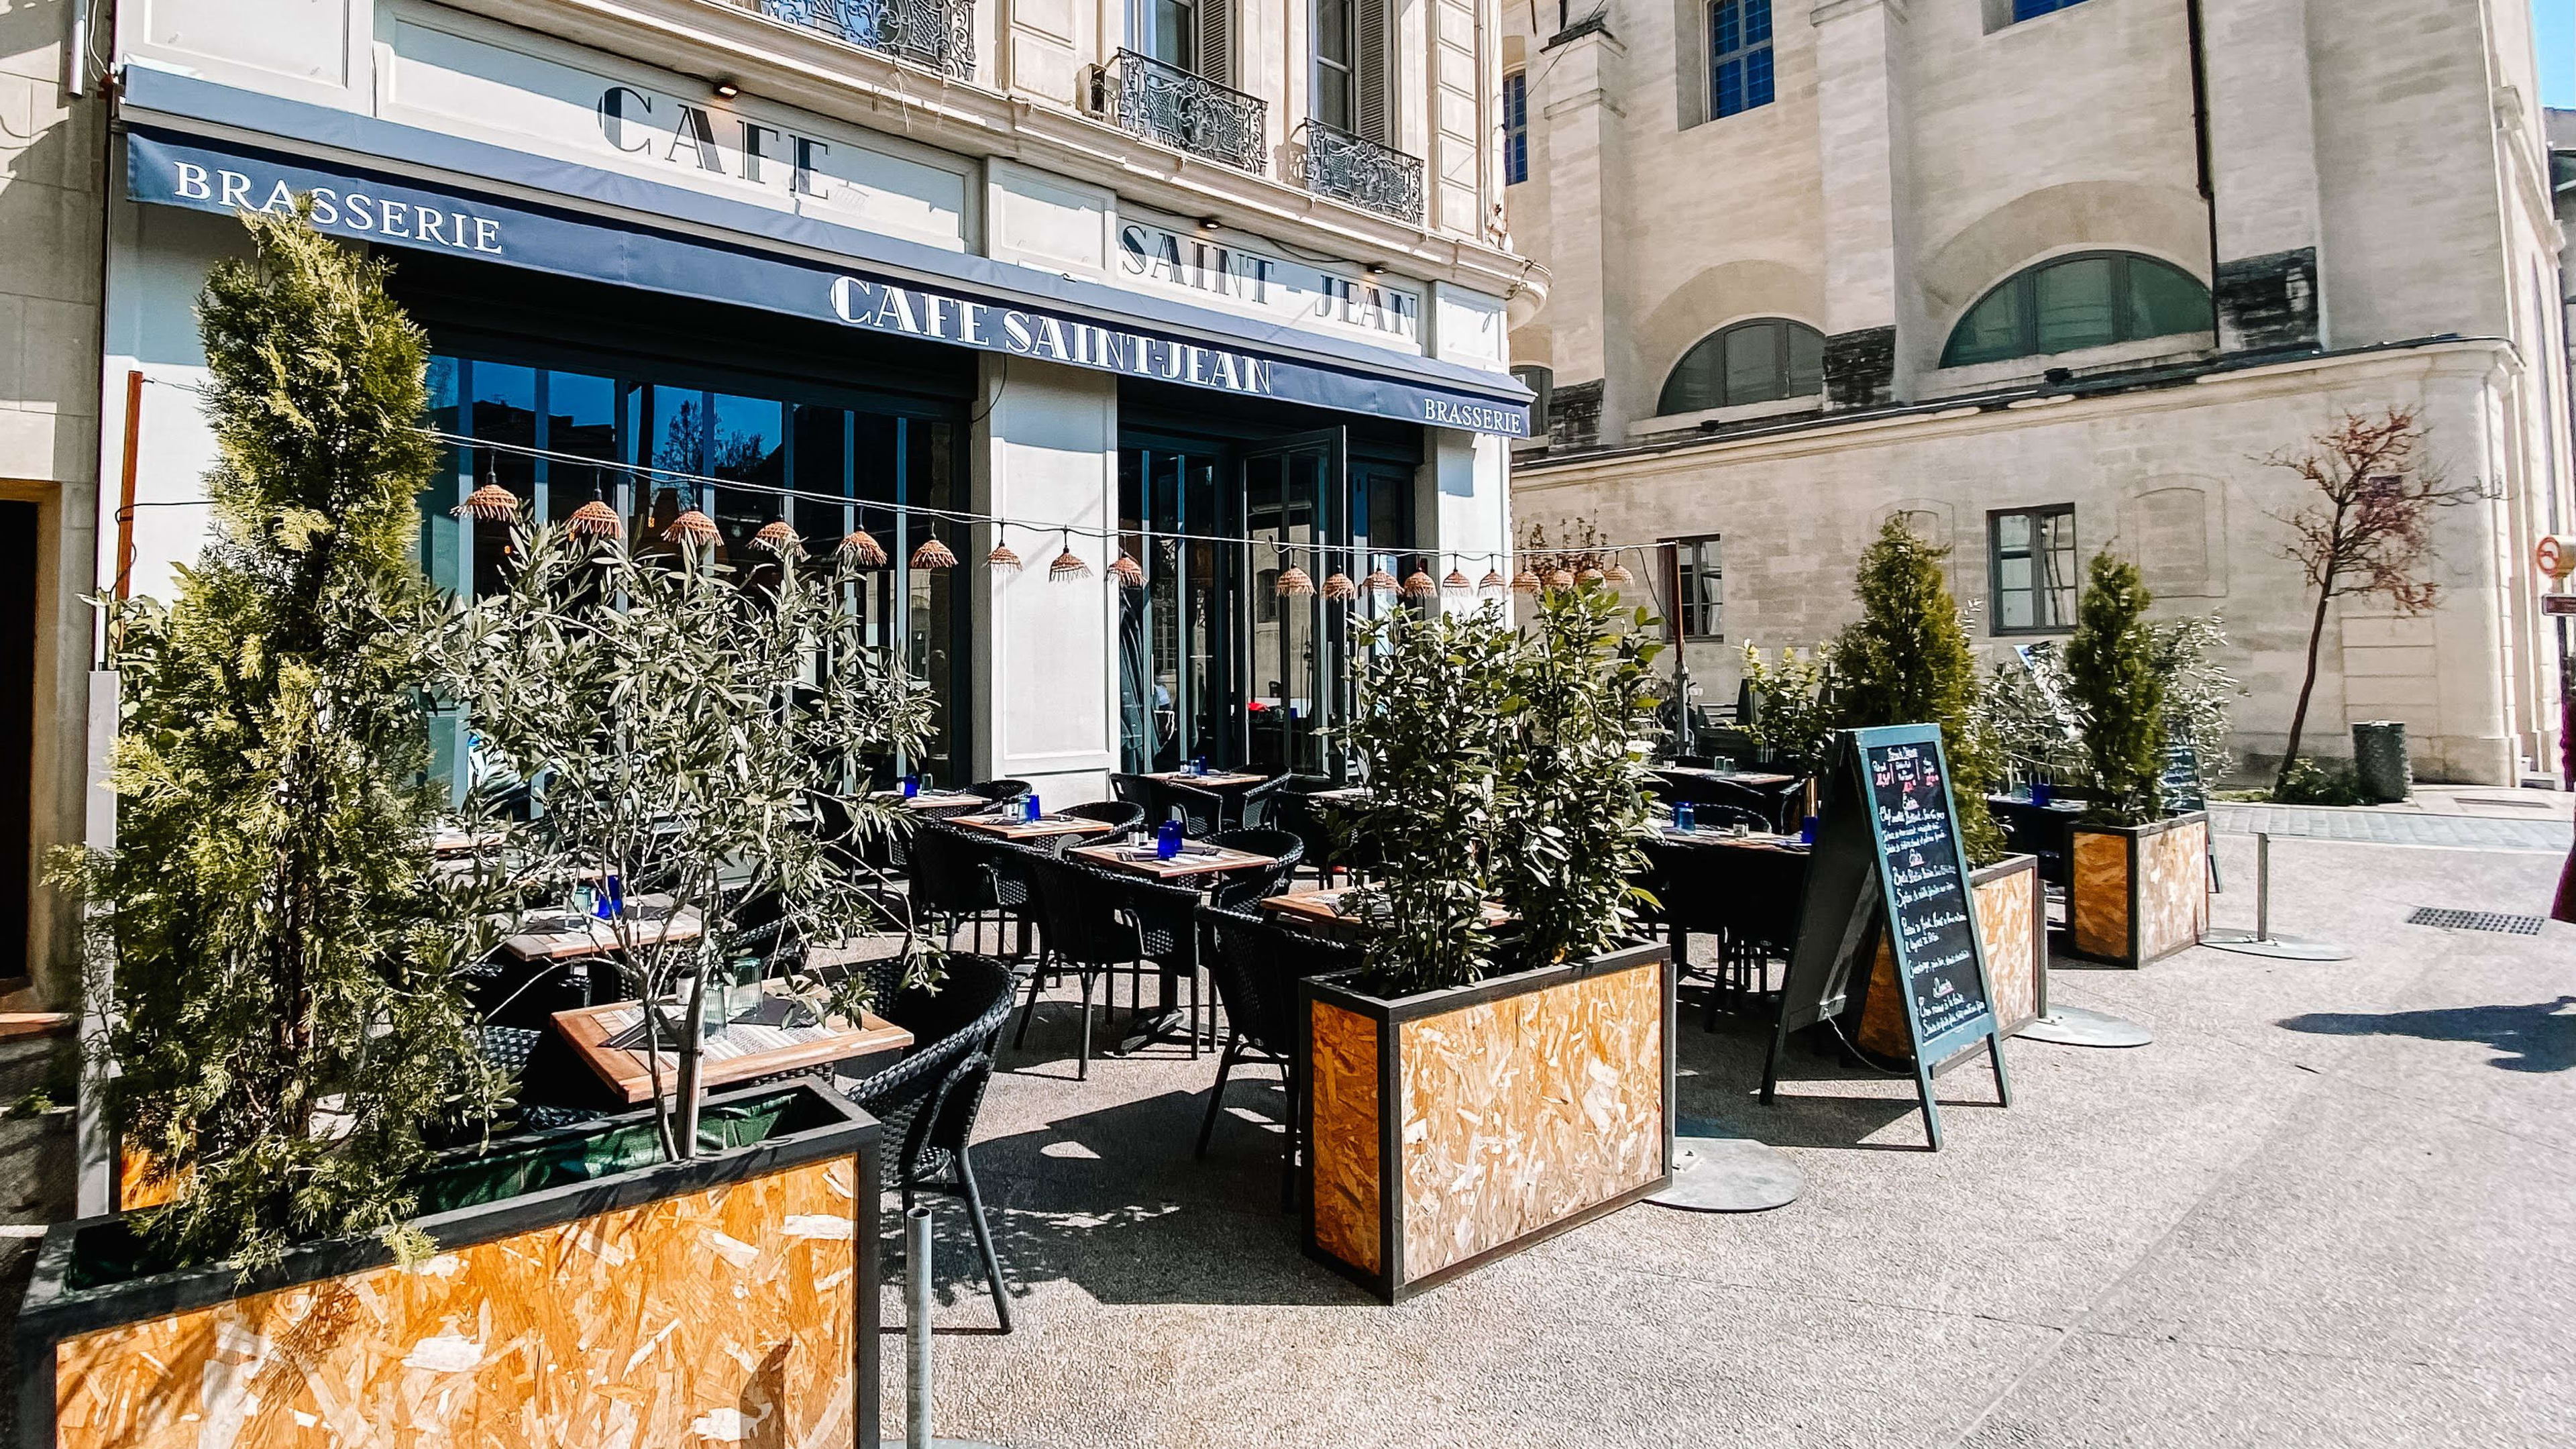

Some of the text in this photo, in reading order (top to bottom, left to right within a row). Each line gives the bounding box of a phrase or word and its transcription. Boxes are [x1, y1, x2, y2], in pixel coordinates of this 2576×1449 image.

[596, 87, 830, 199] CAFE
[172, 160, 503, 254] BRASSERIE
[829, 276, 1273, 395] CAFE SAINT-JEAN
[1424, 398, 1522, 435] BRASSERIE
